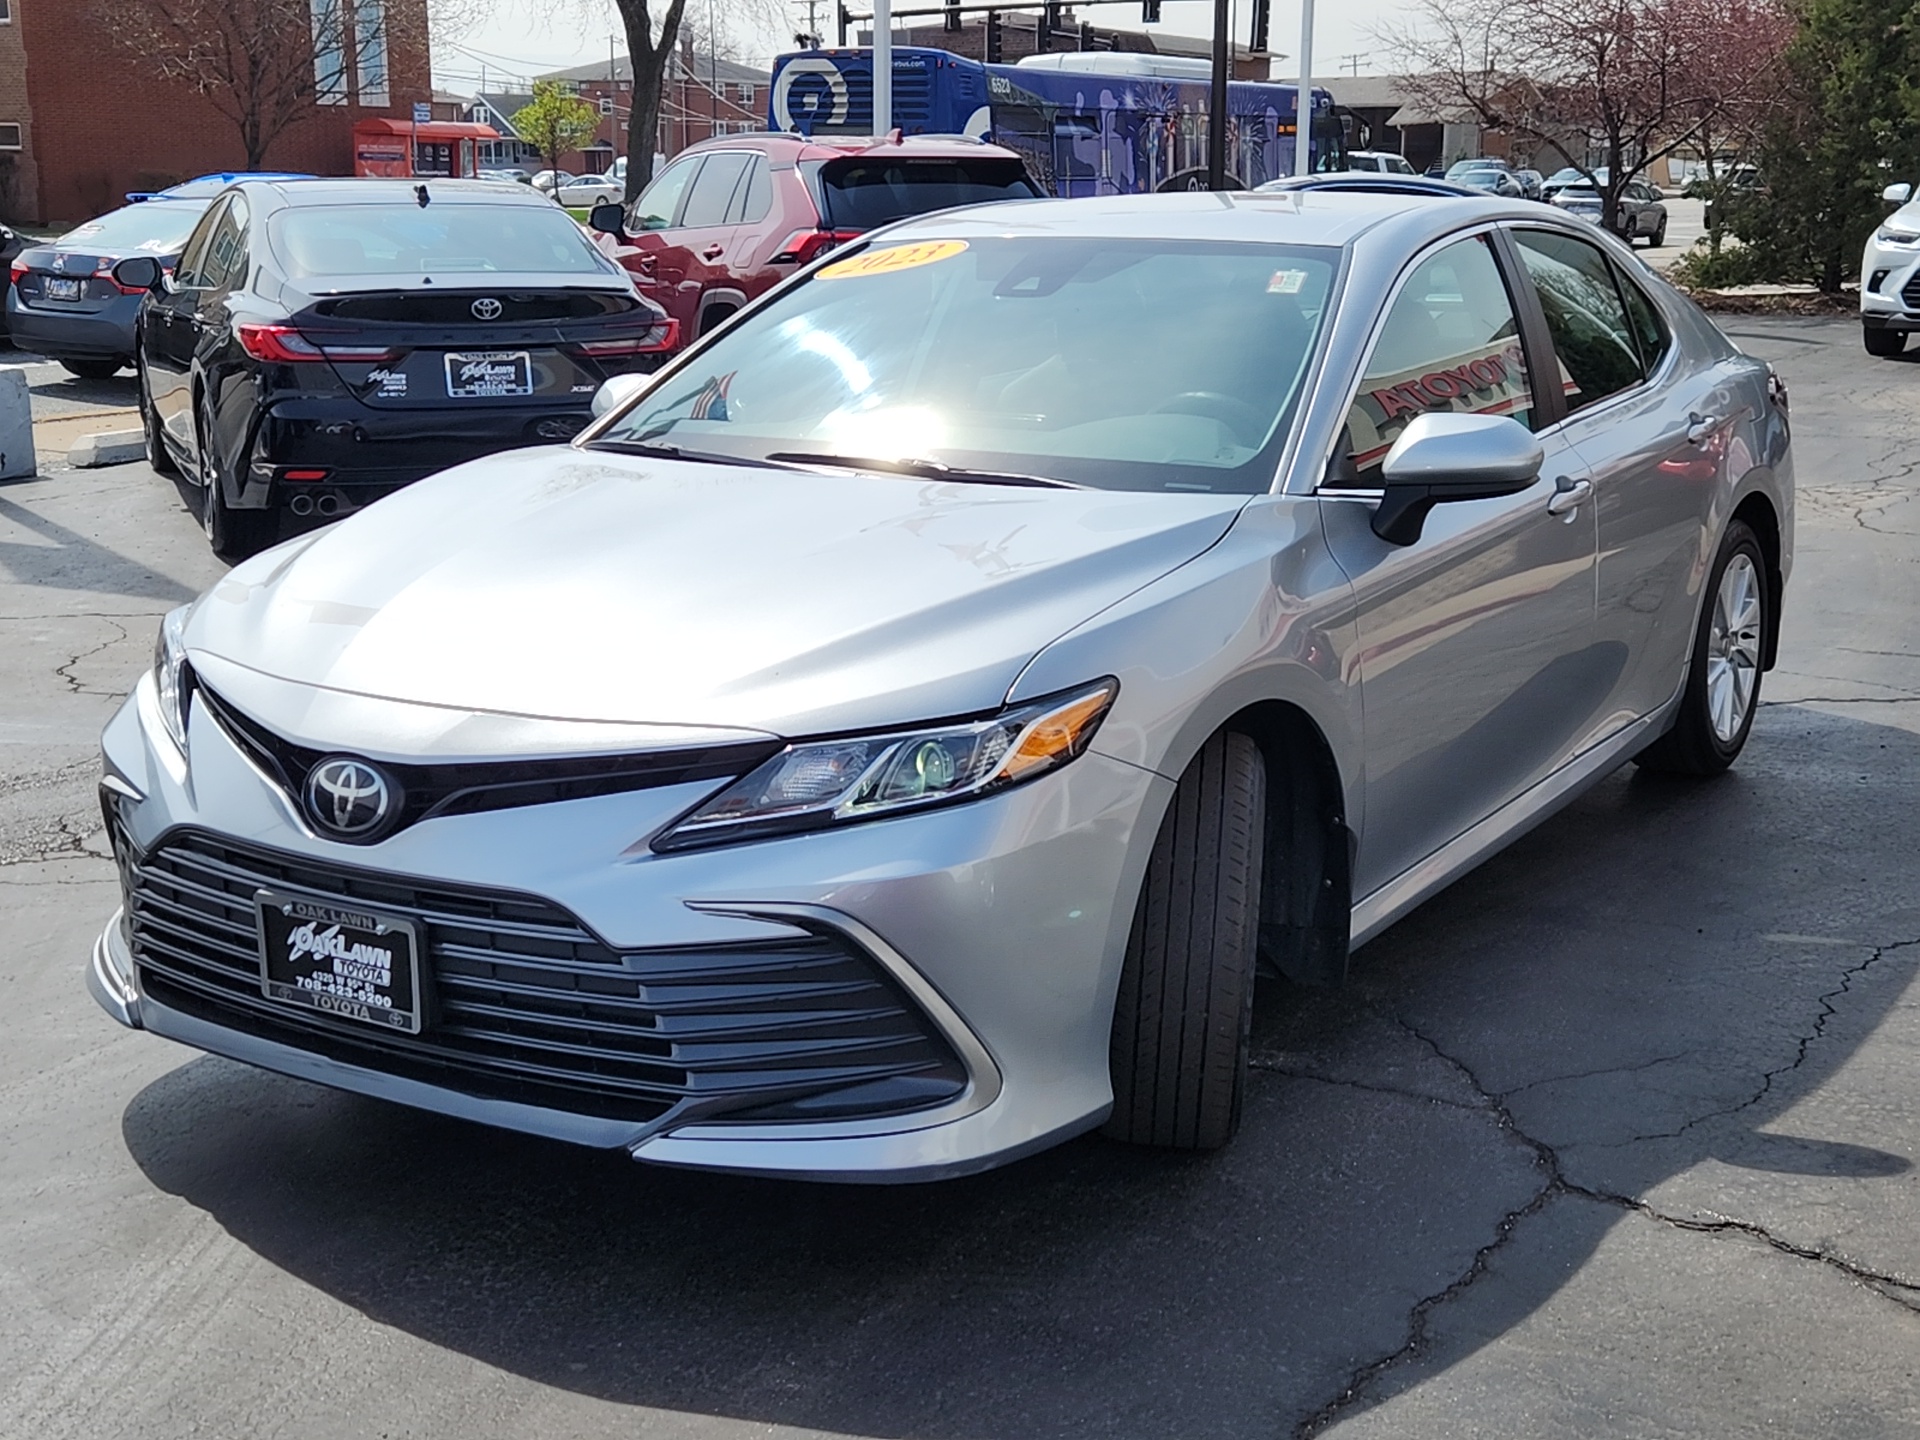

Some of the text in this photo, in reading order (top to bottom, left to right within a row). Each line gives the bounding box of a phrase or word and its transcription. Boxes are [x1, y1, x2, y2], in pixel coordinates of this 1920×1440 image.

[991, 77, 1011, 94] 6523
[835, 243, 946, 275] 2023
[570, 384, 595, 392] XSE
[296, 904, 373, 929] OAK LAWN
[336, 975, 345, 986] W
[340, 960, 384, 983] TOYOTA
[311, 994, 371, 1019] TOYOTA
